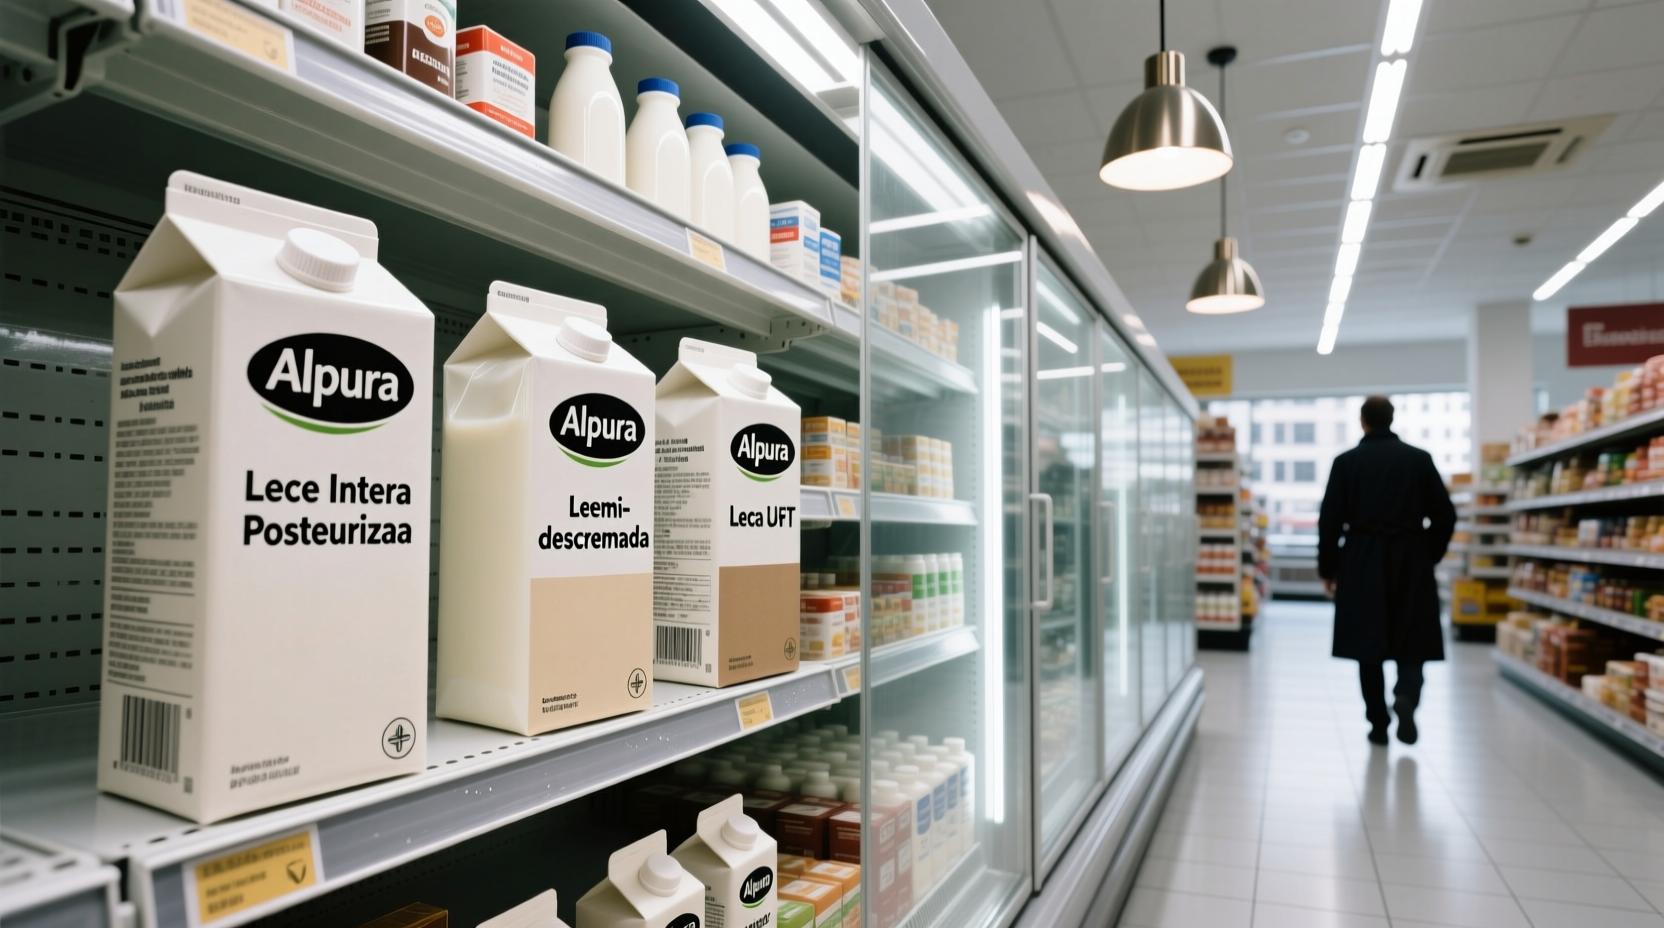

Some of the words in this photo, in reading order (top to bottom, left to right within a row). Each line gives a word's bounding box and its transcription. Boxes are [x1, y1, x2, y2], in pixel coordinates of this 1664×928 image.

[265, 347, 400, 408] Alpura
[559, 405, 638, 448] Alpura
[737, 432, 790, 468] Alpura
[245, 470, 320, 503] Lece
[330, 474, 411, 505] Intera
[569, 495, 631, 519] Leemi-
[730, 505, 764, 528] Leca
[766, 505, 796, 528] UFT
[243, 514, 412, 546] Posteurizaa
[538, 525, 650, 550] descremada
